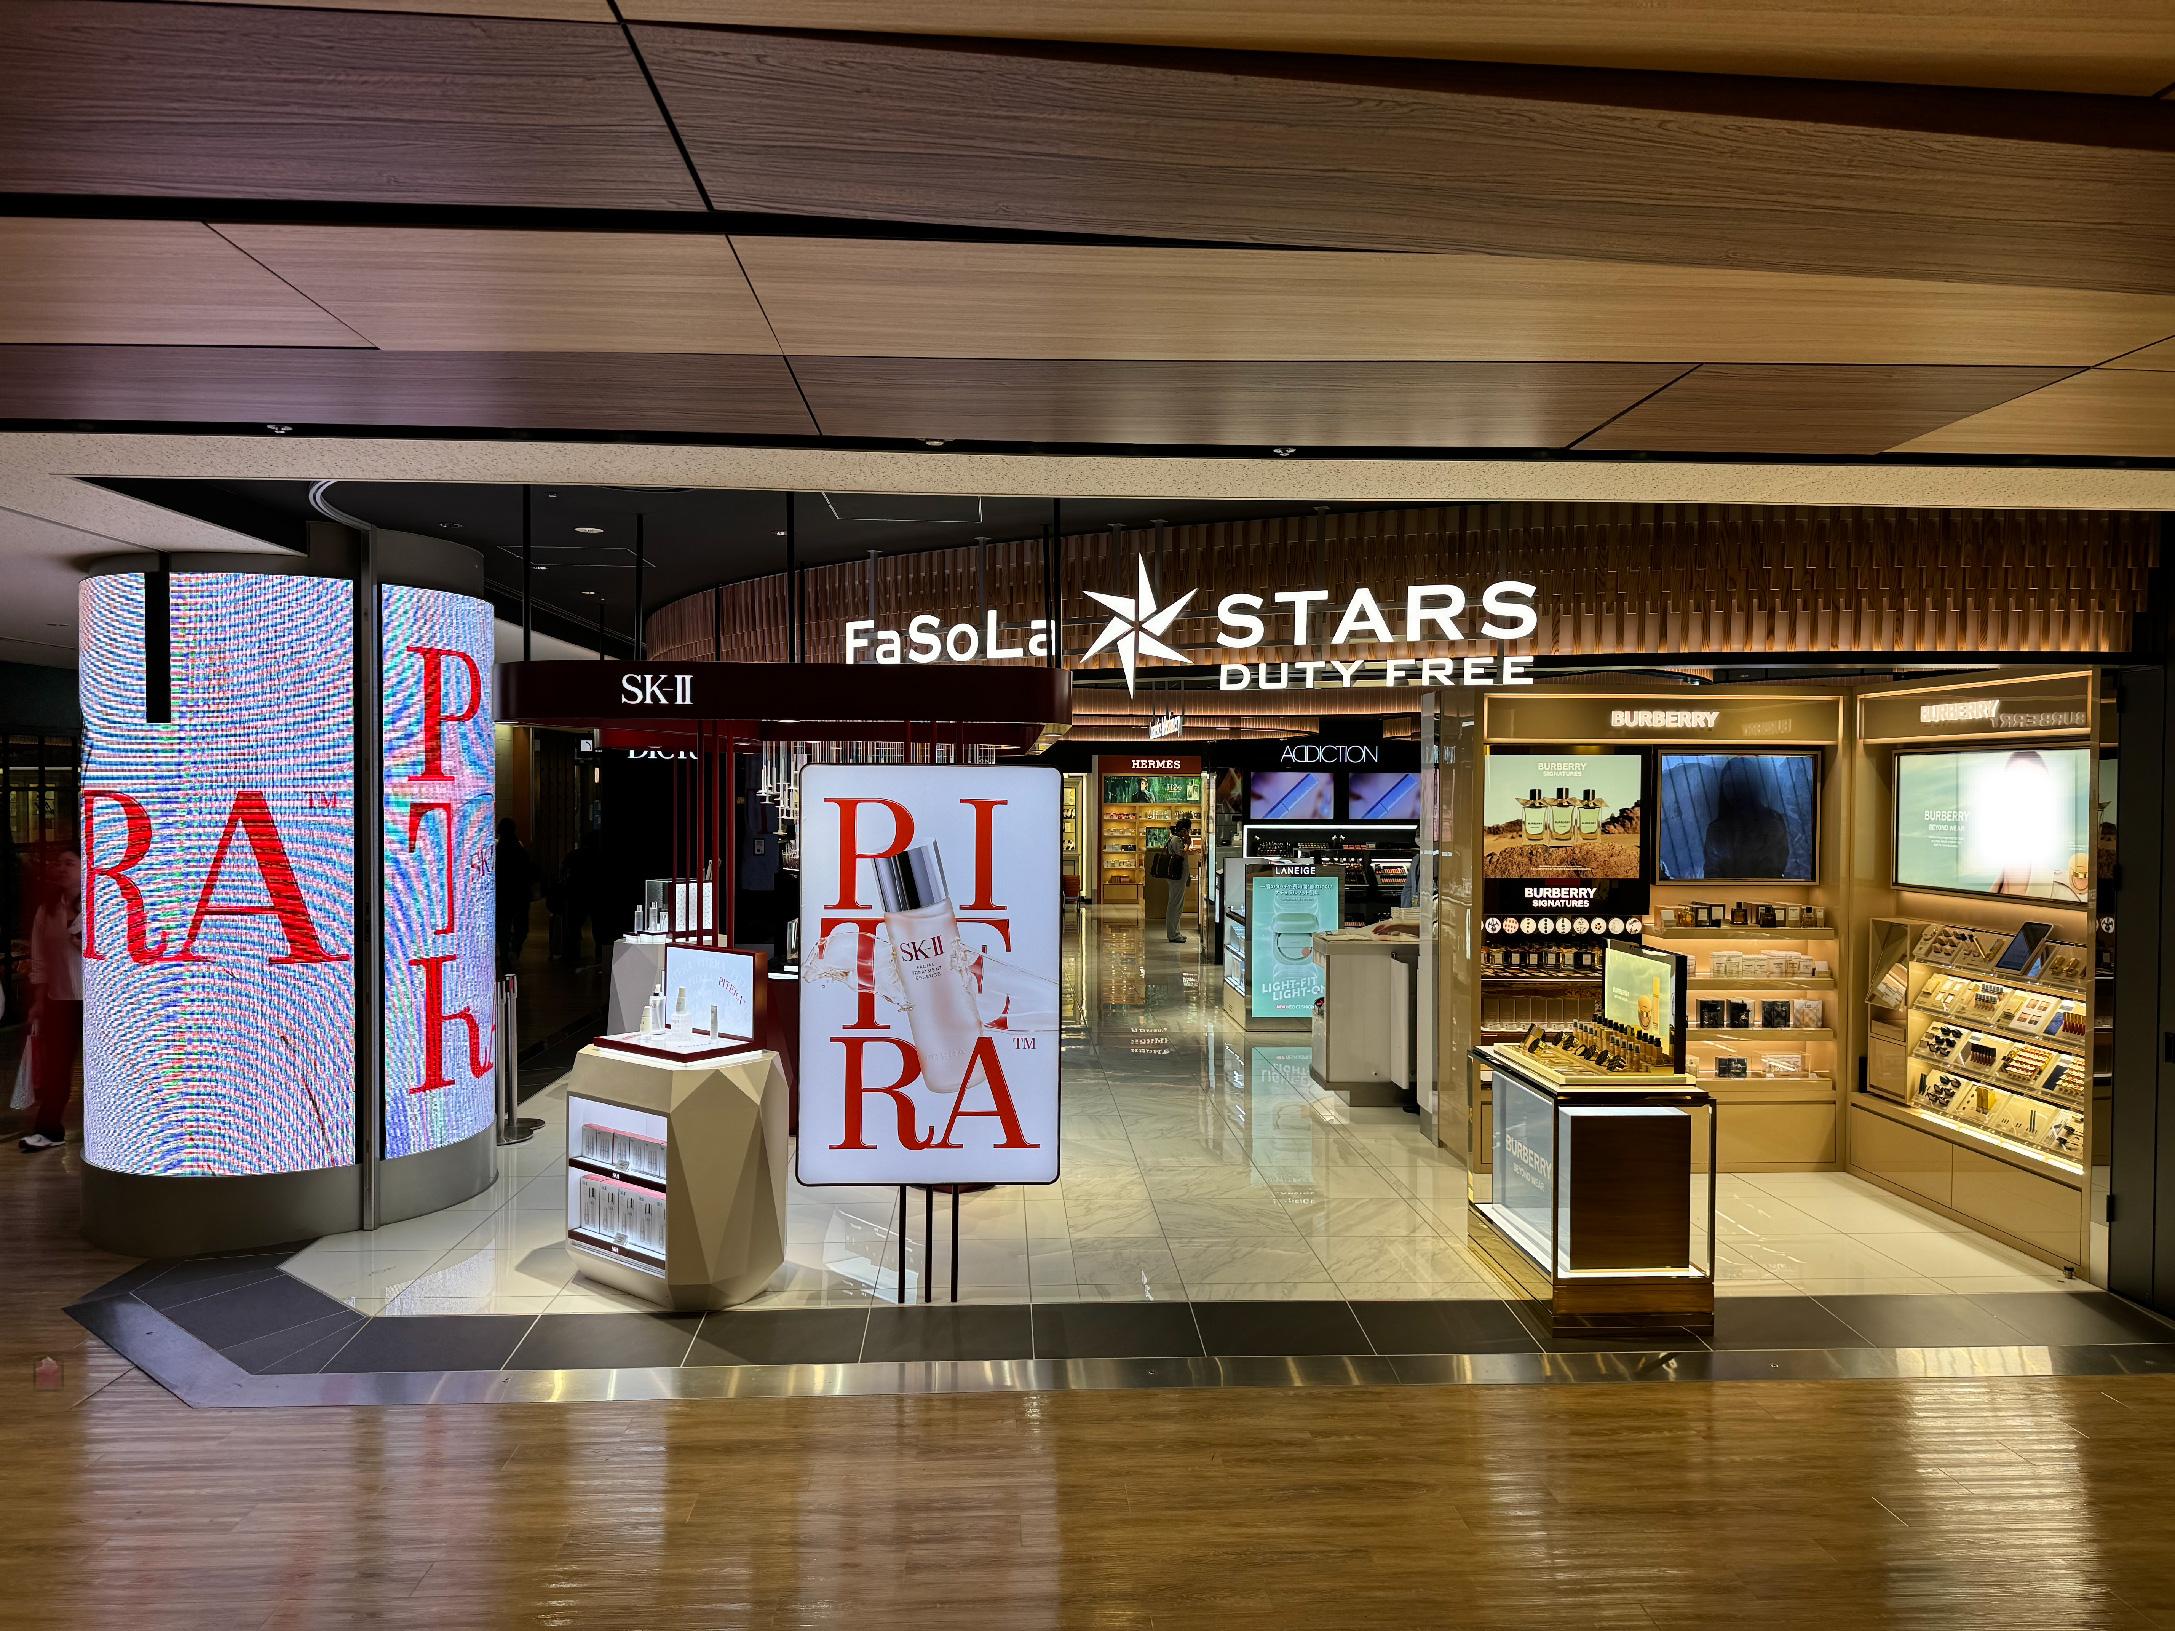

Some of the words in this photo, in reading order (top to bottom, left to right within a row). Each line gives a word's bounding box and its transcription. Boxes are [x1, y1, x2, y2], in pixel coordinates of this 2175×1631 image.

[1216, 580, 1538, 649] STARS
[845, 609, 1056, 665] FaSoLa
[1219, 659, 1365, 691] DUTY
[1386, 656, 1534, 687] FREE
[621, 673, 694, 705] SK-II
[1611, 710, 1720, 728] BURBERRY
[1920, 699, 2000, 723] BURBERRY
[1281, 745, 1378, 763] ADDICTION
[1538, 762, 1587, 771] BURBERRY
[1924, 810, 1969, 822] BURBERRY
[1275, 866, 1316, 875] LANEIGE
[1524, 887, 1598, 899] BURBERRY
[1532, 899, 1590, 908] SIGNATURES
[899, 935, 944, 962] SK-II
[1261, 976, 1317, 994] LIGHT-FIT
[828, 1036, 1041, 1151] RA
[1505, 1133, 1552, 1181] BURBERRY
